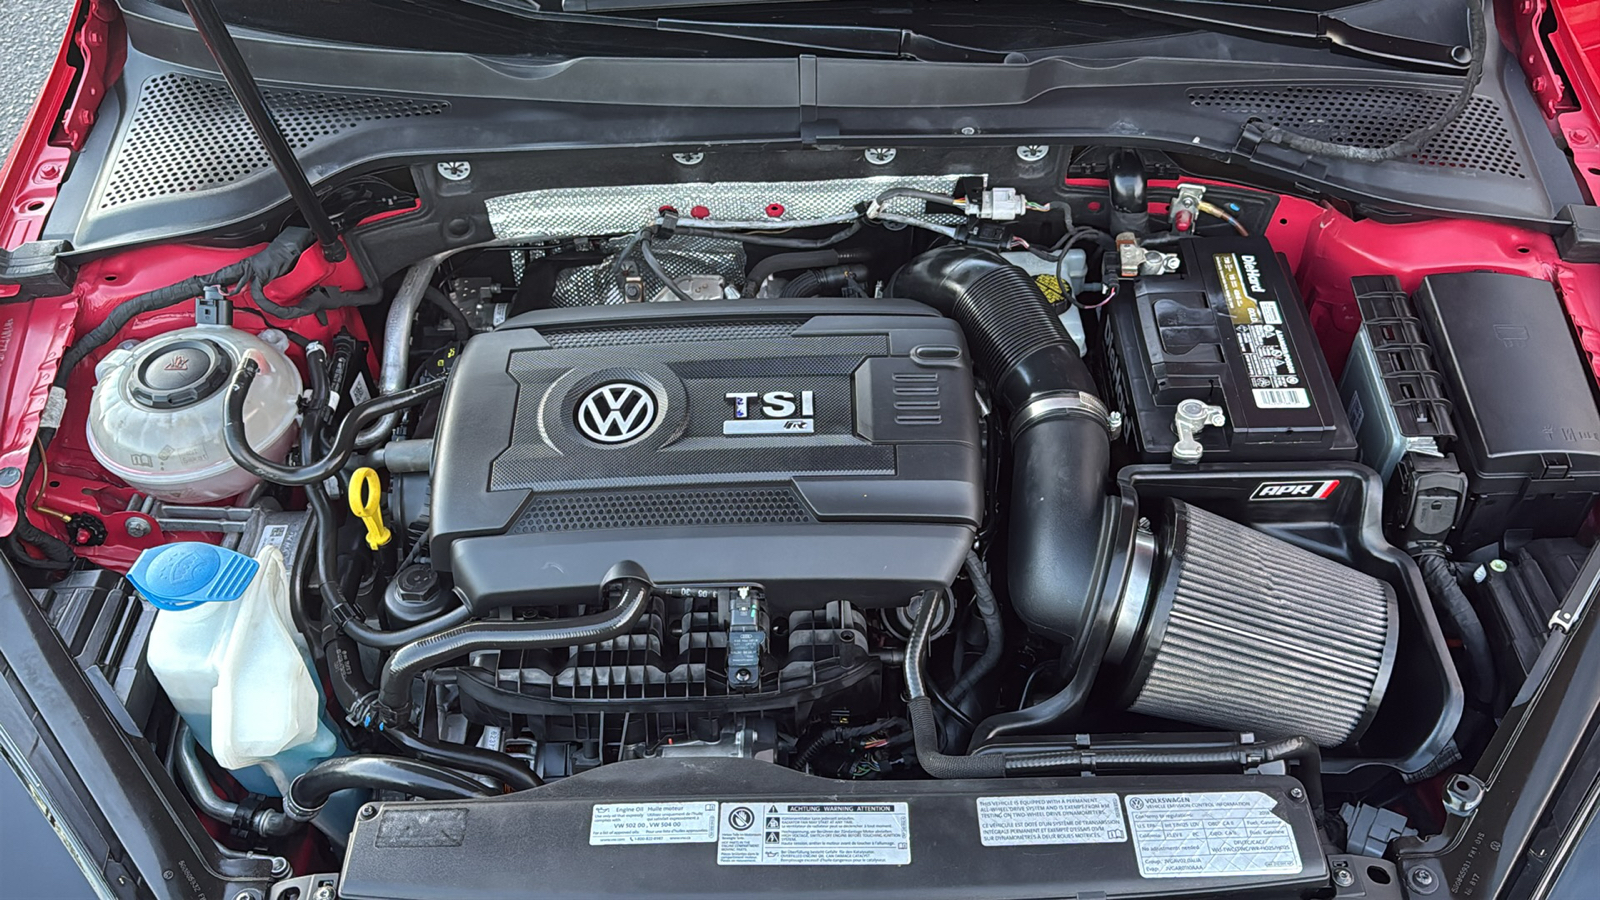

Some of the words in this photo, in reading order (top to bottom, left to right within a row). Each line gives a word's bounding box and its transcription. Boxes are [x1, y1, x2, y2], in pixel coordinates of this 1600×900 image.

[1240, 254, 1266, 293] DieHard
[726, 391, 814, 418] TSI
[1259, 485, 1314, 496] APR
